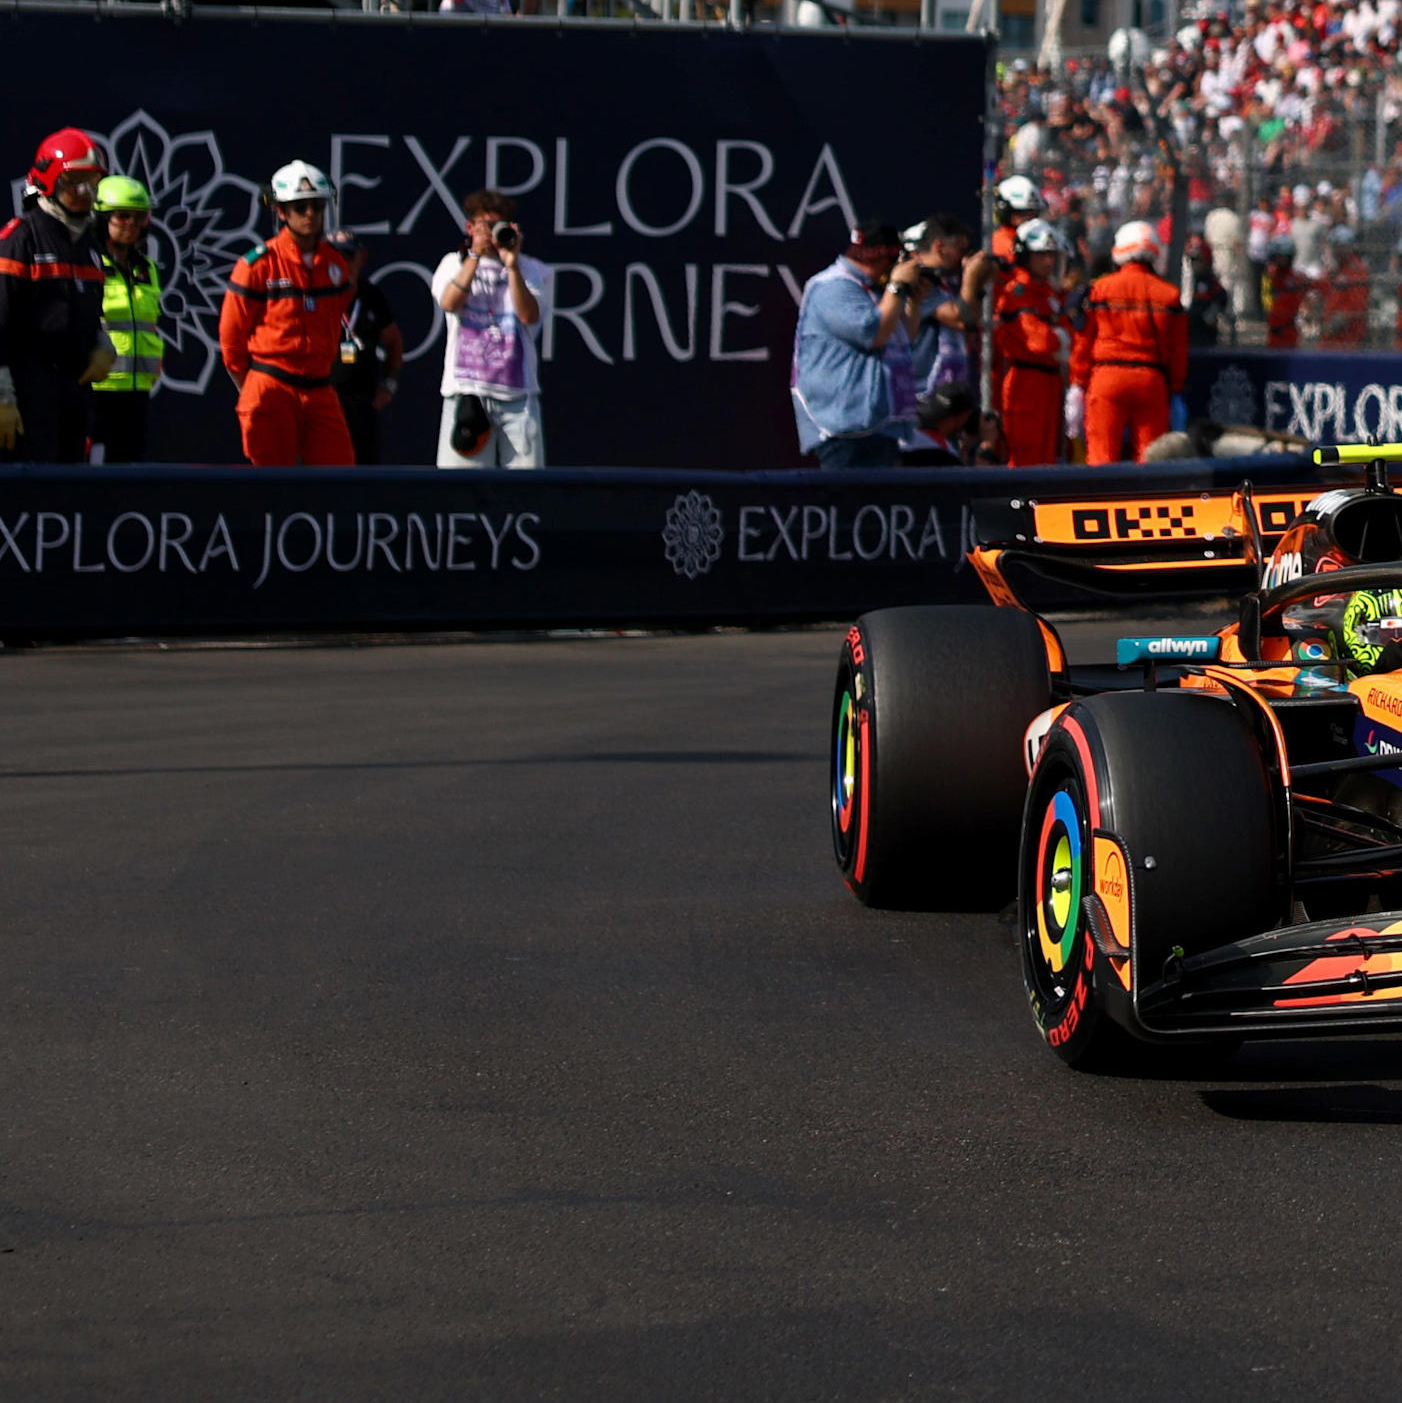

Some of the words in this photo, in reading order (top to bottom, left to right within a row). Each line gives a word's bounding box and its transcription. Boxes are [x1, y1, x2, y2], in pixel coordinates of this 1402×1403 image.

[329, 133, 858, 241] EXPLORA
[738, 504, 946, 562] EXPLORA
[1072, 506, 1197, 540] OKX
[0, 511, 240, 572] XPLORA
[252, 512, 541, 589] JOURNEYS
[1147, 638, 1208, 655] allwyn
[1367, 687, 1402, 717] RICHARD
[1100, 876, 1124, 902] workday
